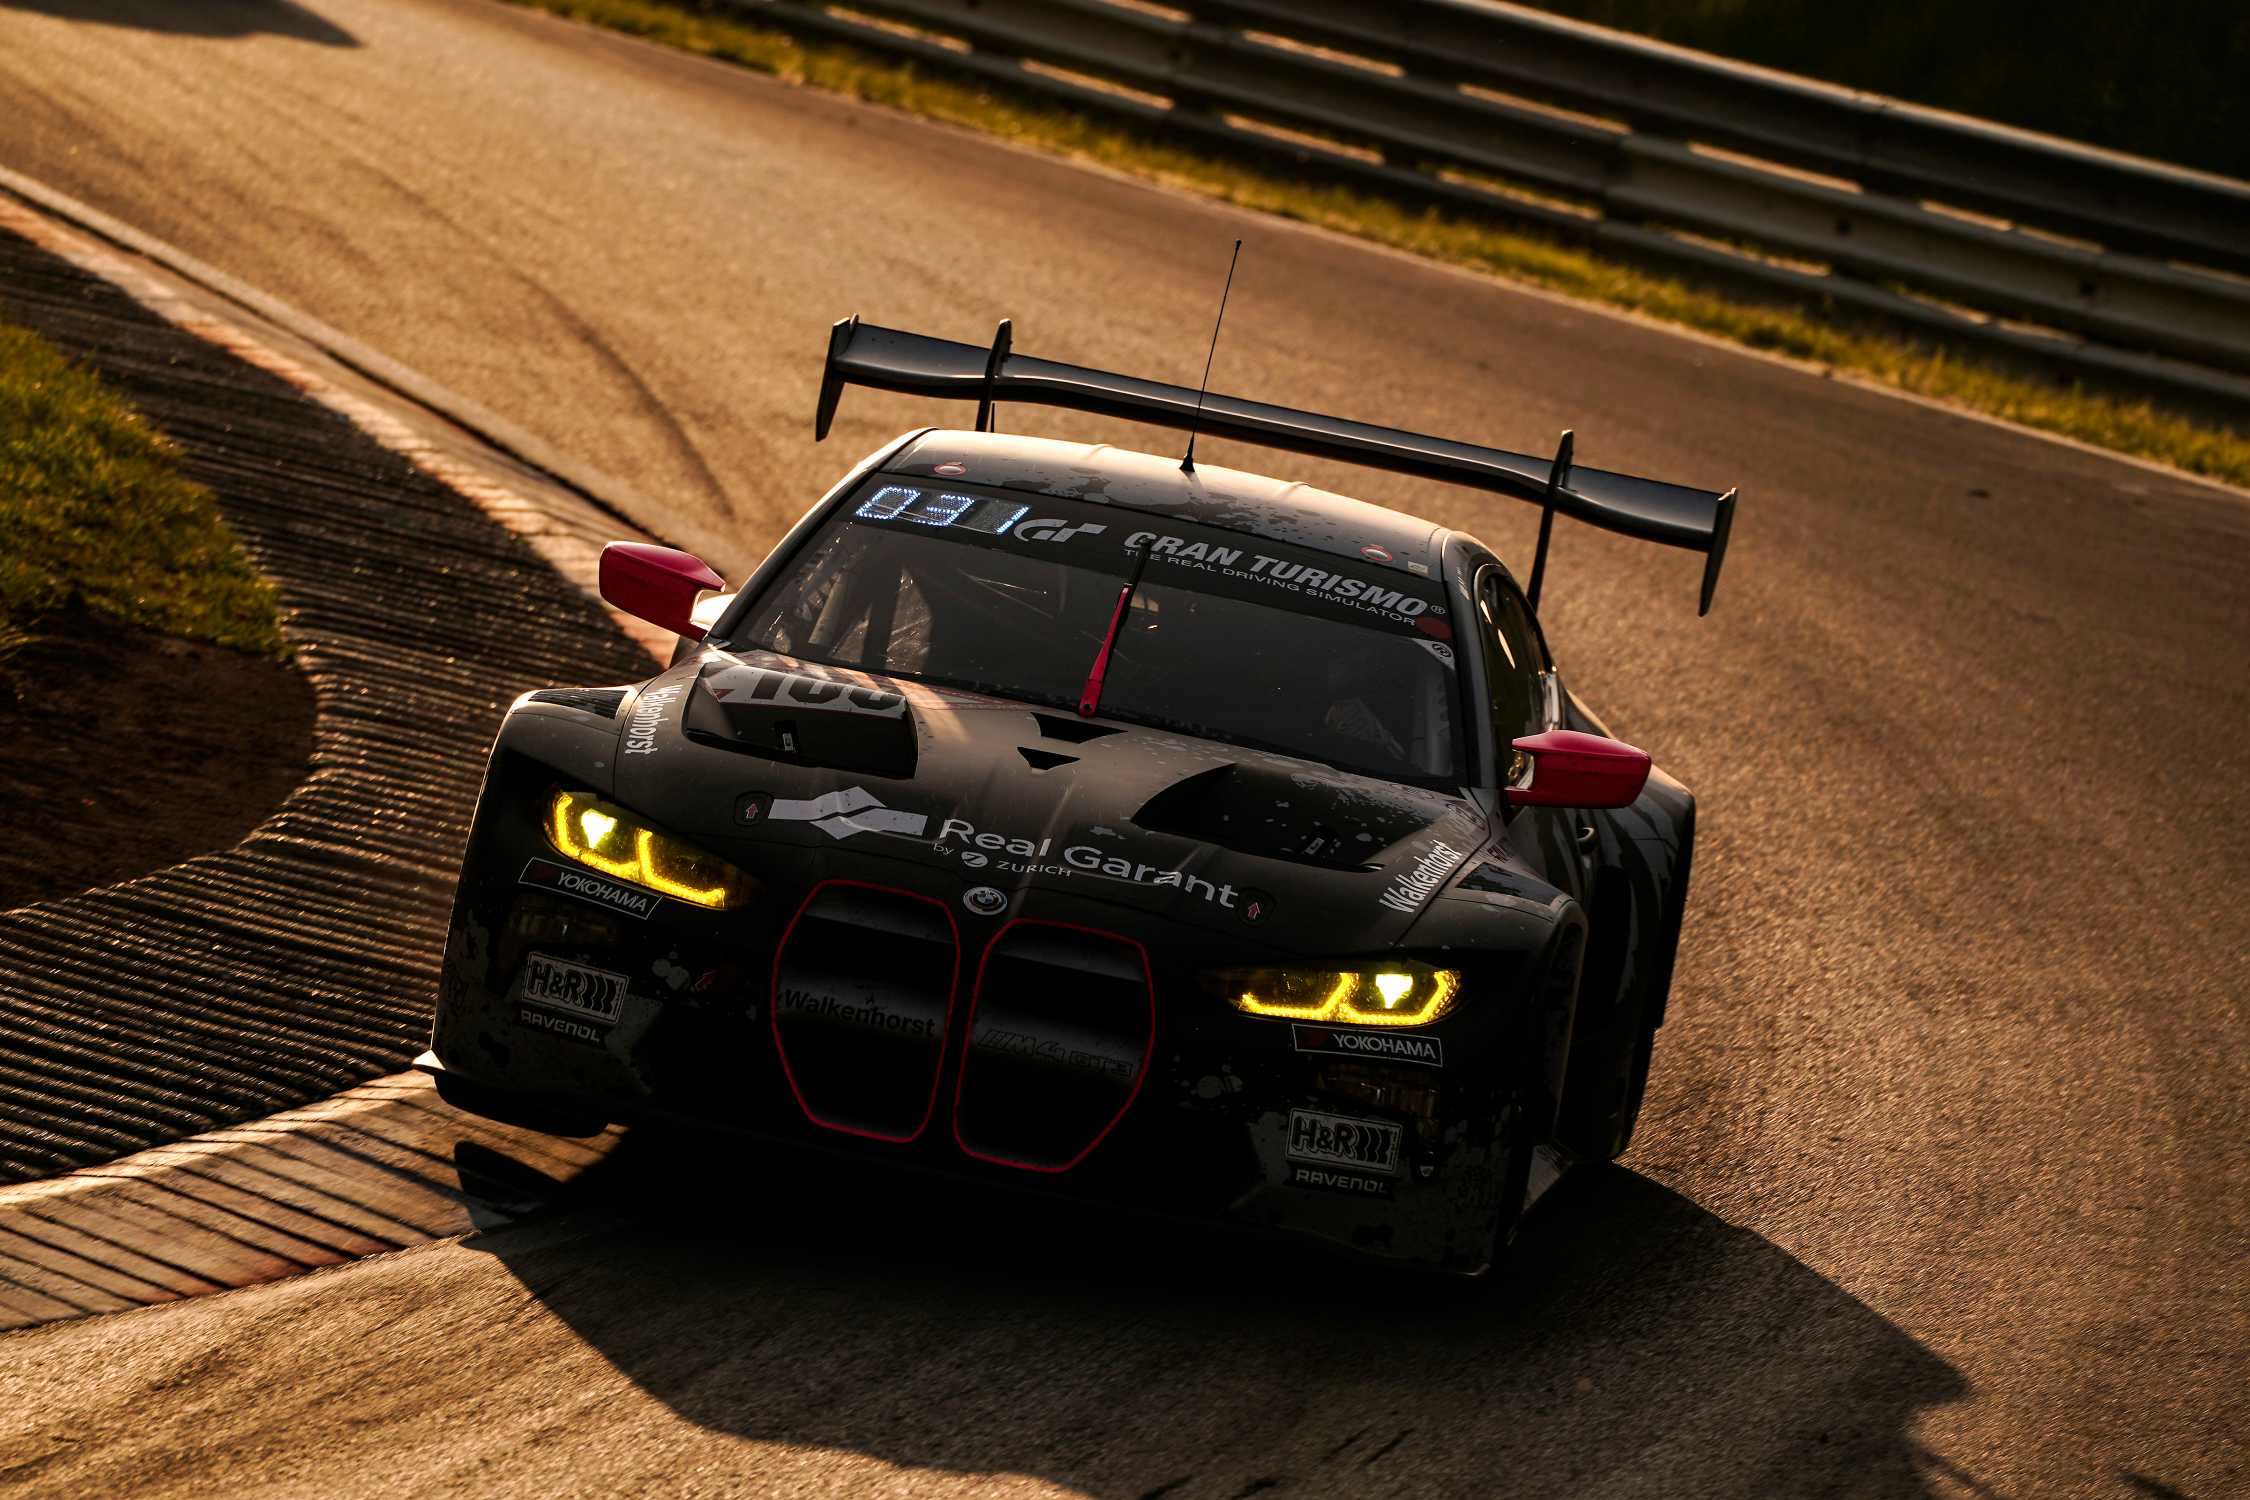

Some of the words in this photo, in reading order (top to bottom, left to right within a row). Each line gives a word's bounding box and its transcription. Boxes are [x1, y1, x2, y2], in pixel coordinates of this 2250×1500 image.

[1123, 531, 1244, 566] GRAN
[1167, 557, 1217, 573] REAL
[1222, 568, 1300, 591] DRIVING
[1304, 588, 1416, 626] SIMULATOR
[933, 842, 956, 856] by
[996, 860, 1073, 877] ZURICH
[939, 818, 1053, 857] Real
[1063, 845, 1239, 910] Garant
[1378, 839, 1463, 913] Walkenhorst
[556, 871, 649, 912] YOKOHAMA
[520, 1009, 601, 1044] RAVENOL
[785, 988, 936, 1038] Walkenhorst
[1332, 1033, 1437, 1059] YOKOHAMA
[1295, 1168, 1390, 1196] RAVENOL
